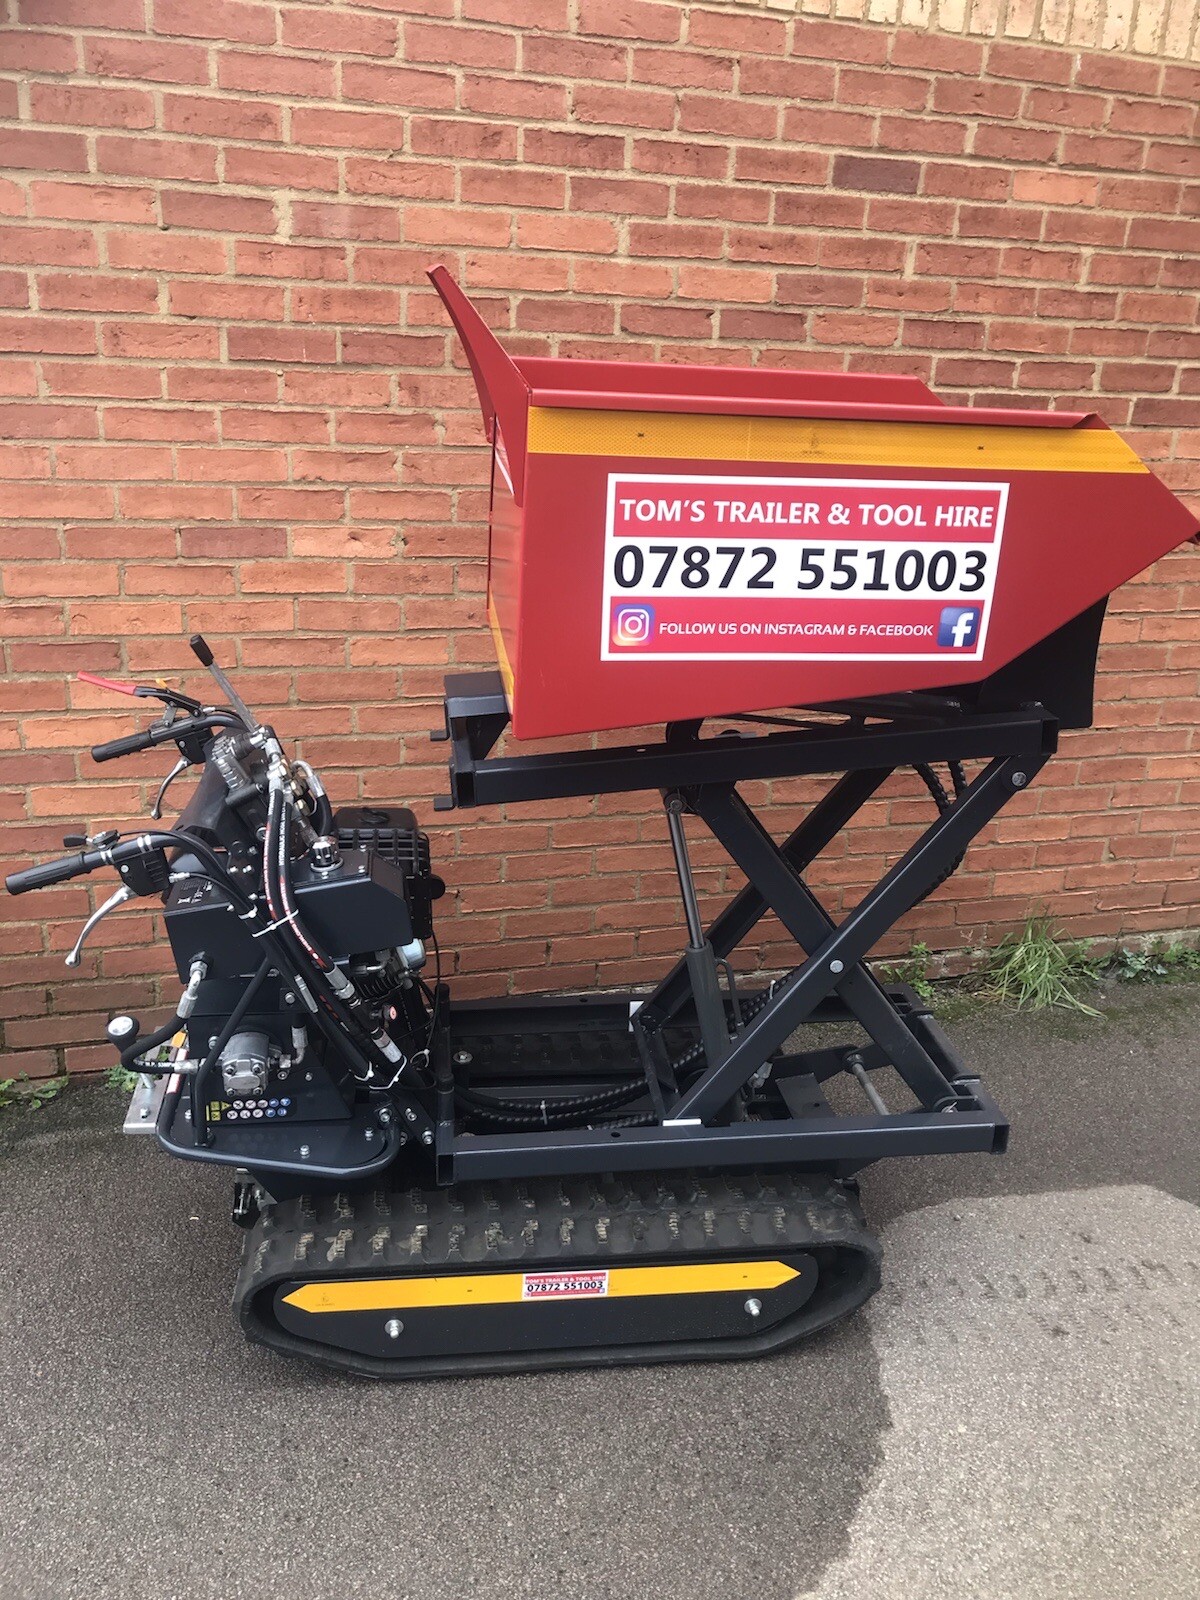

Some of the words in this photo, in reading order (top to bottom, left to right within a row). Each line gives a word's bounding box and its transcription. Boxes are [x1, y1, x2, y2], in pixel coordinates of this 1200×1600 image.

[619, 499, 706, 522] TOM'S
[713, 501, 820, 525] TRAILER
[827, 503, 851, 525] &
[857, 503, 927, 527] TOOL
[935, 505, 994, 528] HIRE
[613, 544, 777, 589] 07872
[797, 548, 988, 592] 551003
[659, 622, 716, 636] FOLLOW
[718, 622, 738, 636] US
[740, 622, 762, 636] ON
[764, 623, 845, 636] INSTAGRAM
[848, 624, 857, 636] &
[859, 624, 933, 637] FACEBOOK
[527, 1282, 560, 1292] 07872
[564, 1281, 604, 1290] 551003
